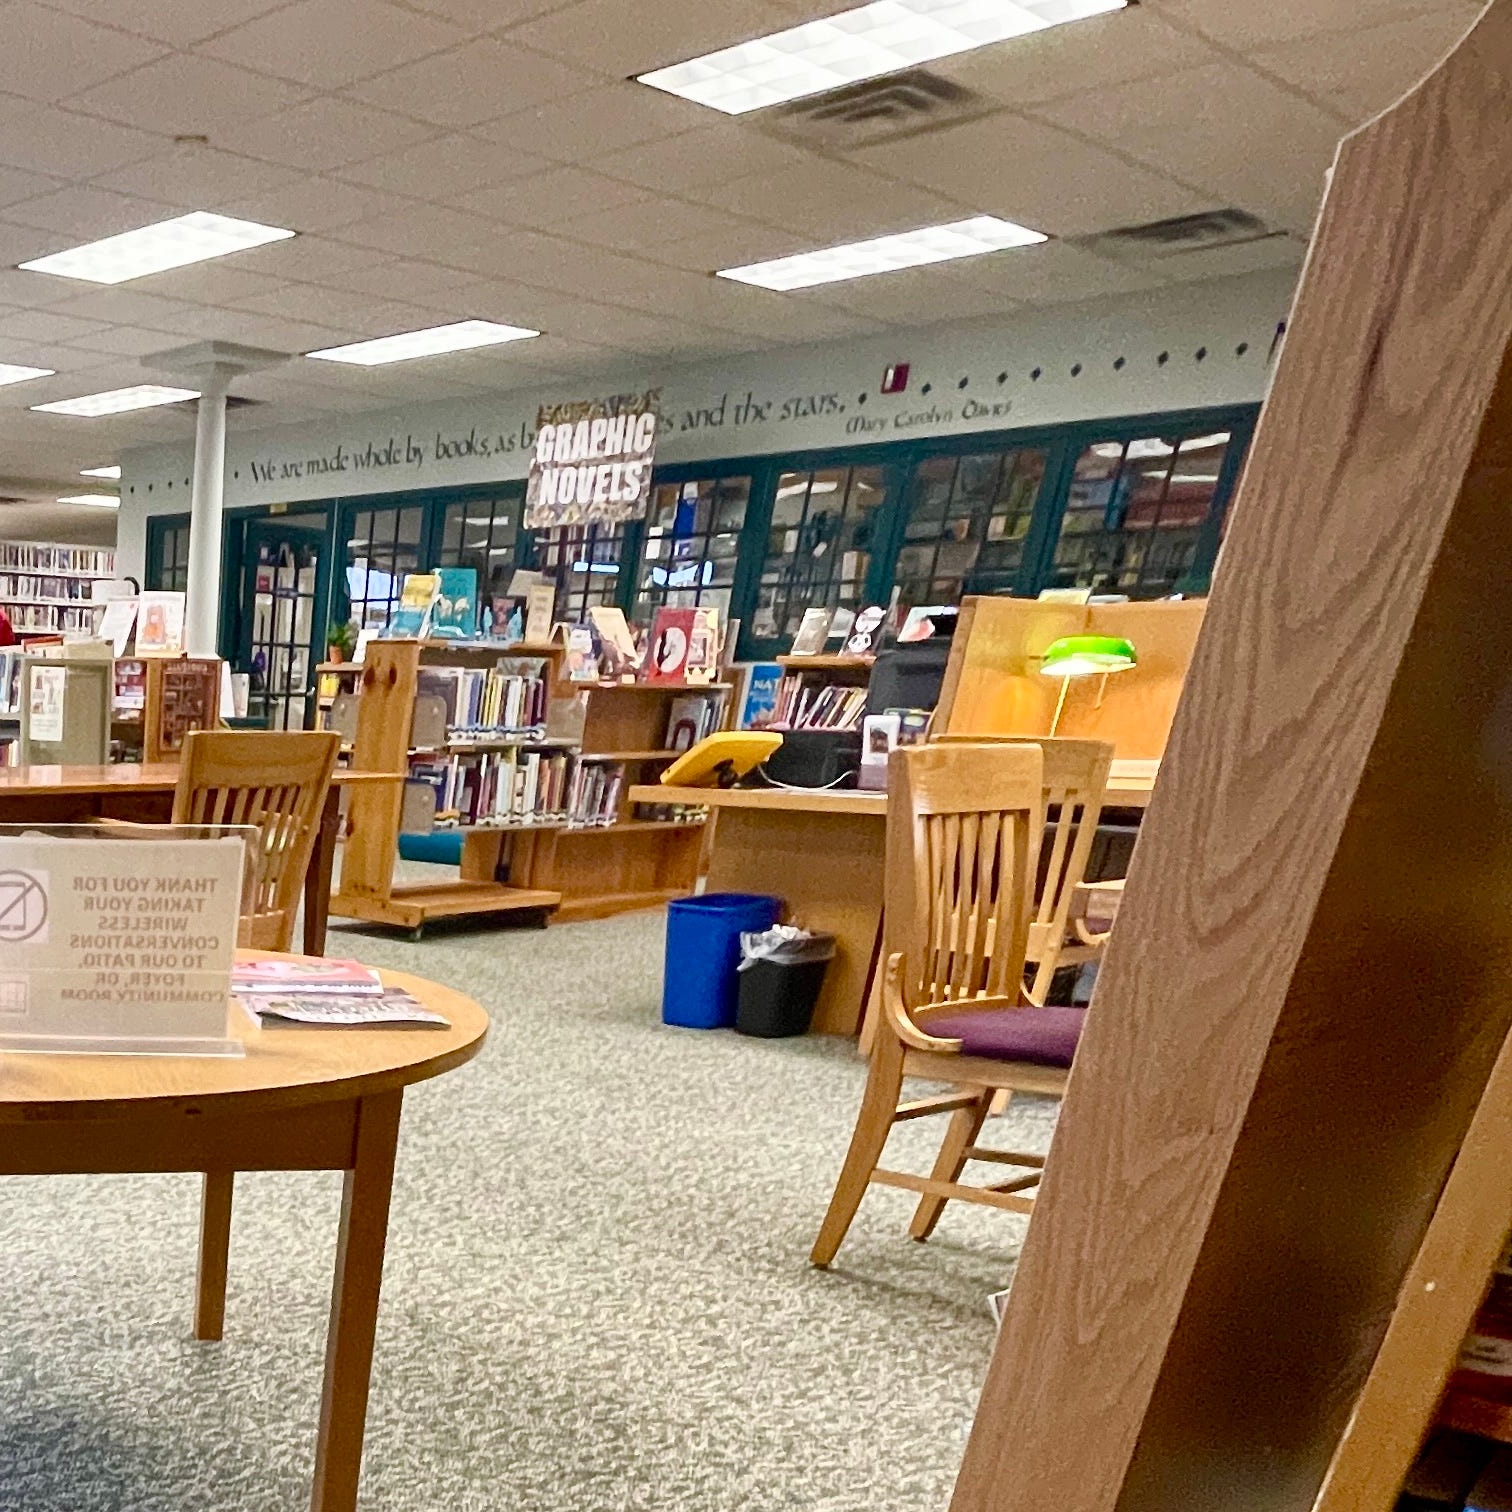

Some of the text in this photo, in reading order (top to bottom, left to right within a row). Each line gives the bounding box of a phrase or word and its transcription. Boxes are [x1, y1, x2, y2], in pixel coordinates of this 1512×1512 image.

[250, 458, 276, 483] We
[280, 461, 304, 479] are
[306, 445, 348, 475] made
[354, 438, 401, 470] whole
[406, 435, 425, 469] by
[434, 424, 492, 460] books,
[494, 434, 516, 453] as
[681, 394, 726, 430] and
[734, 391, 772, 425] the
[536, 412, 656, 464] GRAPHIC
[538, 462, 645, 506] NOVELS
